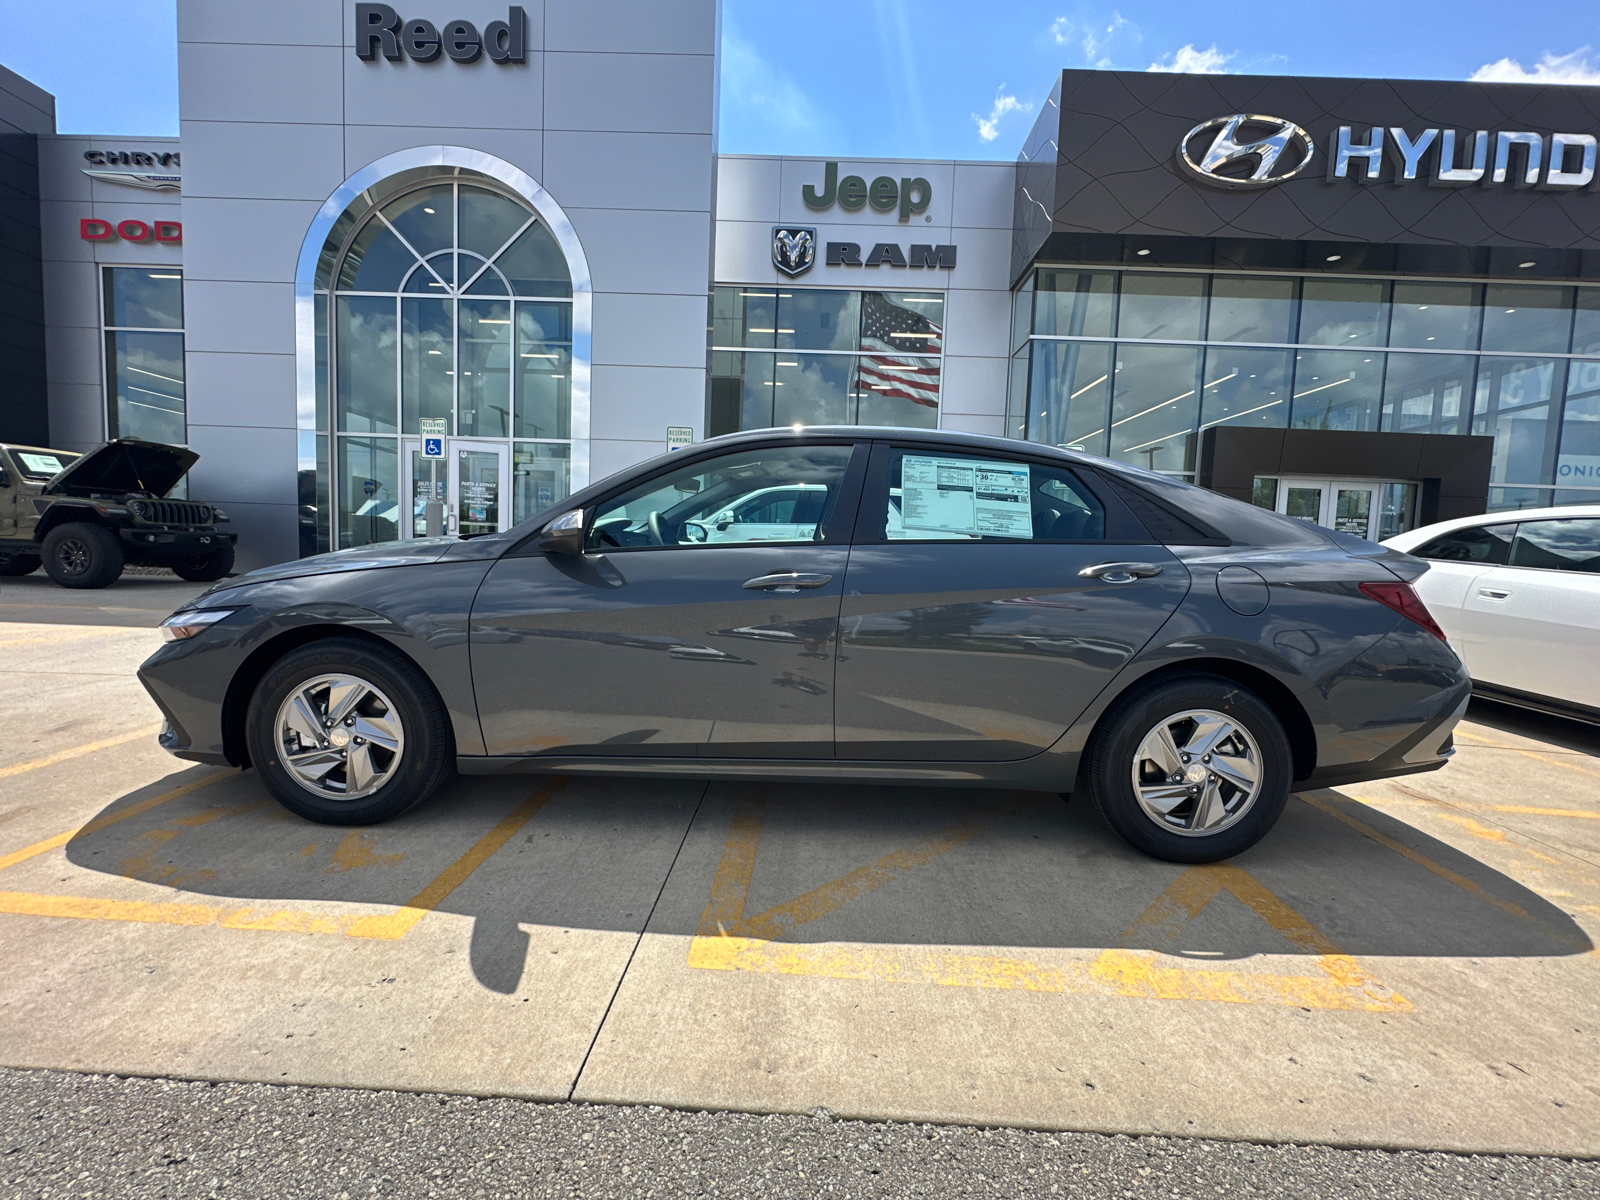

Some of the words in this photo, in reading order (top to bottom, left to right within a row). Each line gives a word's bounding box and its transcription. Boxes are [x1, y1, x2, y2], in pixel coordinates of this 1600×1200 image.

[355, 2, 526, 63] Reed
[1328, 125, 1599, 188] HYUND
[802, 162, 932, 222] Jeep
[826, 242, 957, 269] RAM
[422, 428, 445, 436] PARKING
[669, 429, 691, 437] RESERVED
[669, 436, 691, 444] PARKING
